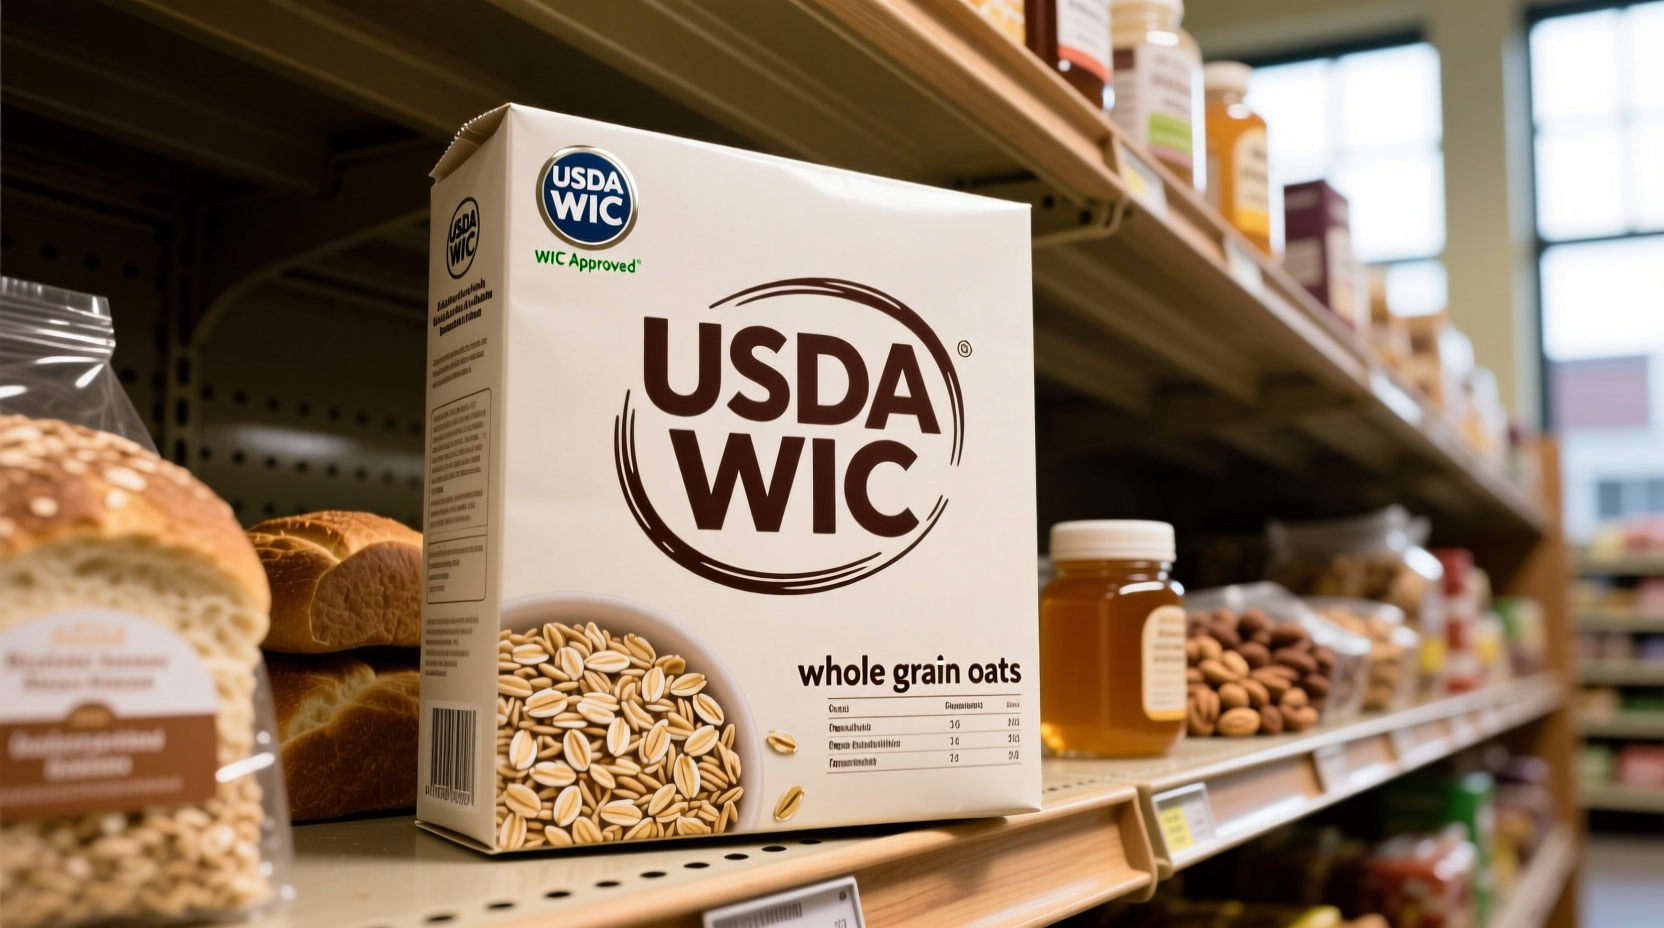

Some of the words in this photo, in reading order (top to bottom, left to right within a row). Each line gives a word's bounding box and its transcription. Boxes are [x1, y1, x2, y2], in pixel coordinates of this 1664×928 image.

[552, 165, 624, 194] USDA
[449, 209, 477, 243] USDA
[550, 190, 623, 226] WIC
[450, 231, 476, 267] WIC
[534, 249, 566, 266] WIC
[643, 316, 941, 434] USDA
[668, 428, 919, 538] WIC
[798, 655, 886, 686] whole
[893, 655, 961, 693] grain
[967, 657, 1022, 684] oats
